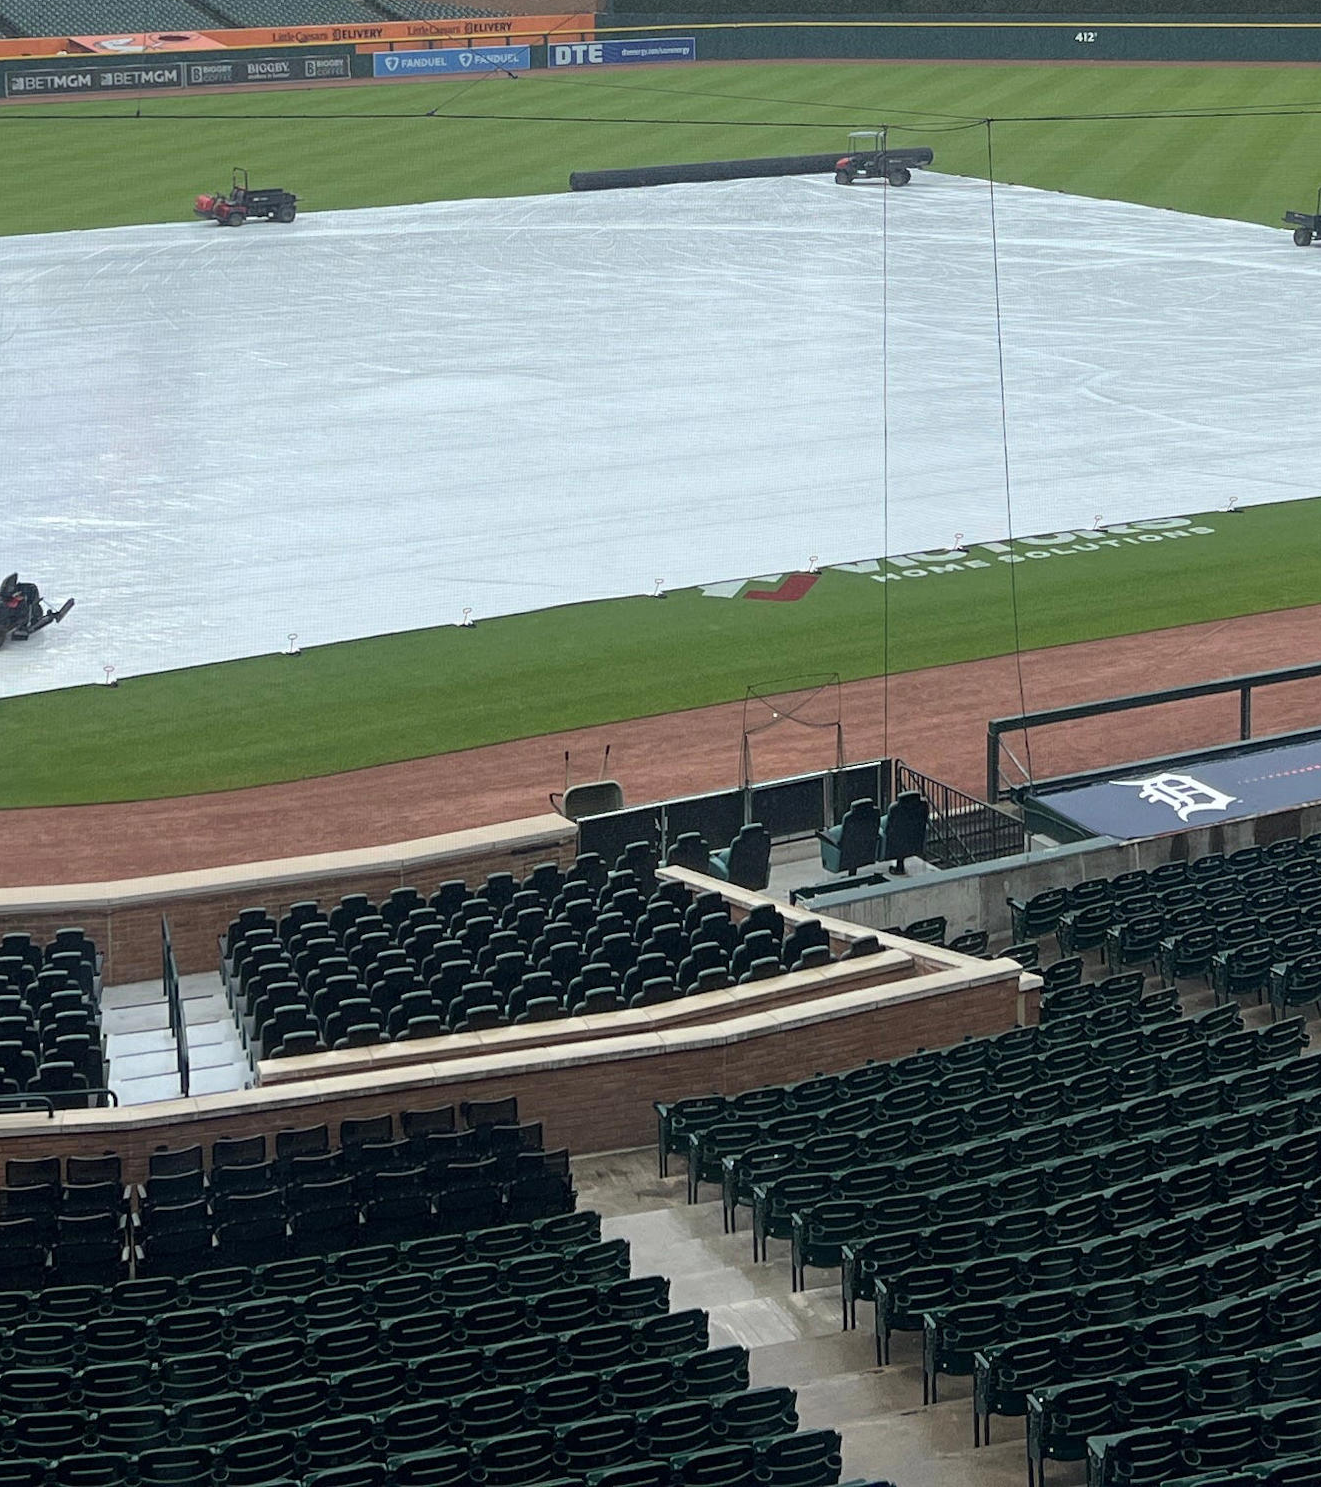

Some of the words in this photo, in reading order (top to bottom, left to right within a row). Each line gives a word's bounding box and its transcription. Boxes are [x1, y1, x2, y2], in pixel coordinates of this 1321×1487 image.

[401, 57, 447, 68] FANDUEL
[474, 53, 520, 64] FANDUEL
[555, 43, 603, 66] DTE
[24, 73, 92, 90] BETMGM
[112, 70, 178, 86] BETMGM
[870, 559, 991, 583] HOME
[996, 526, 1217, 564] SOLUTIONS
